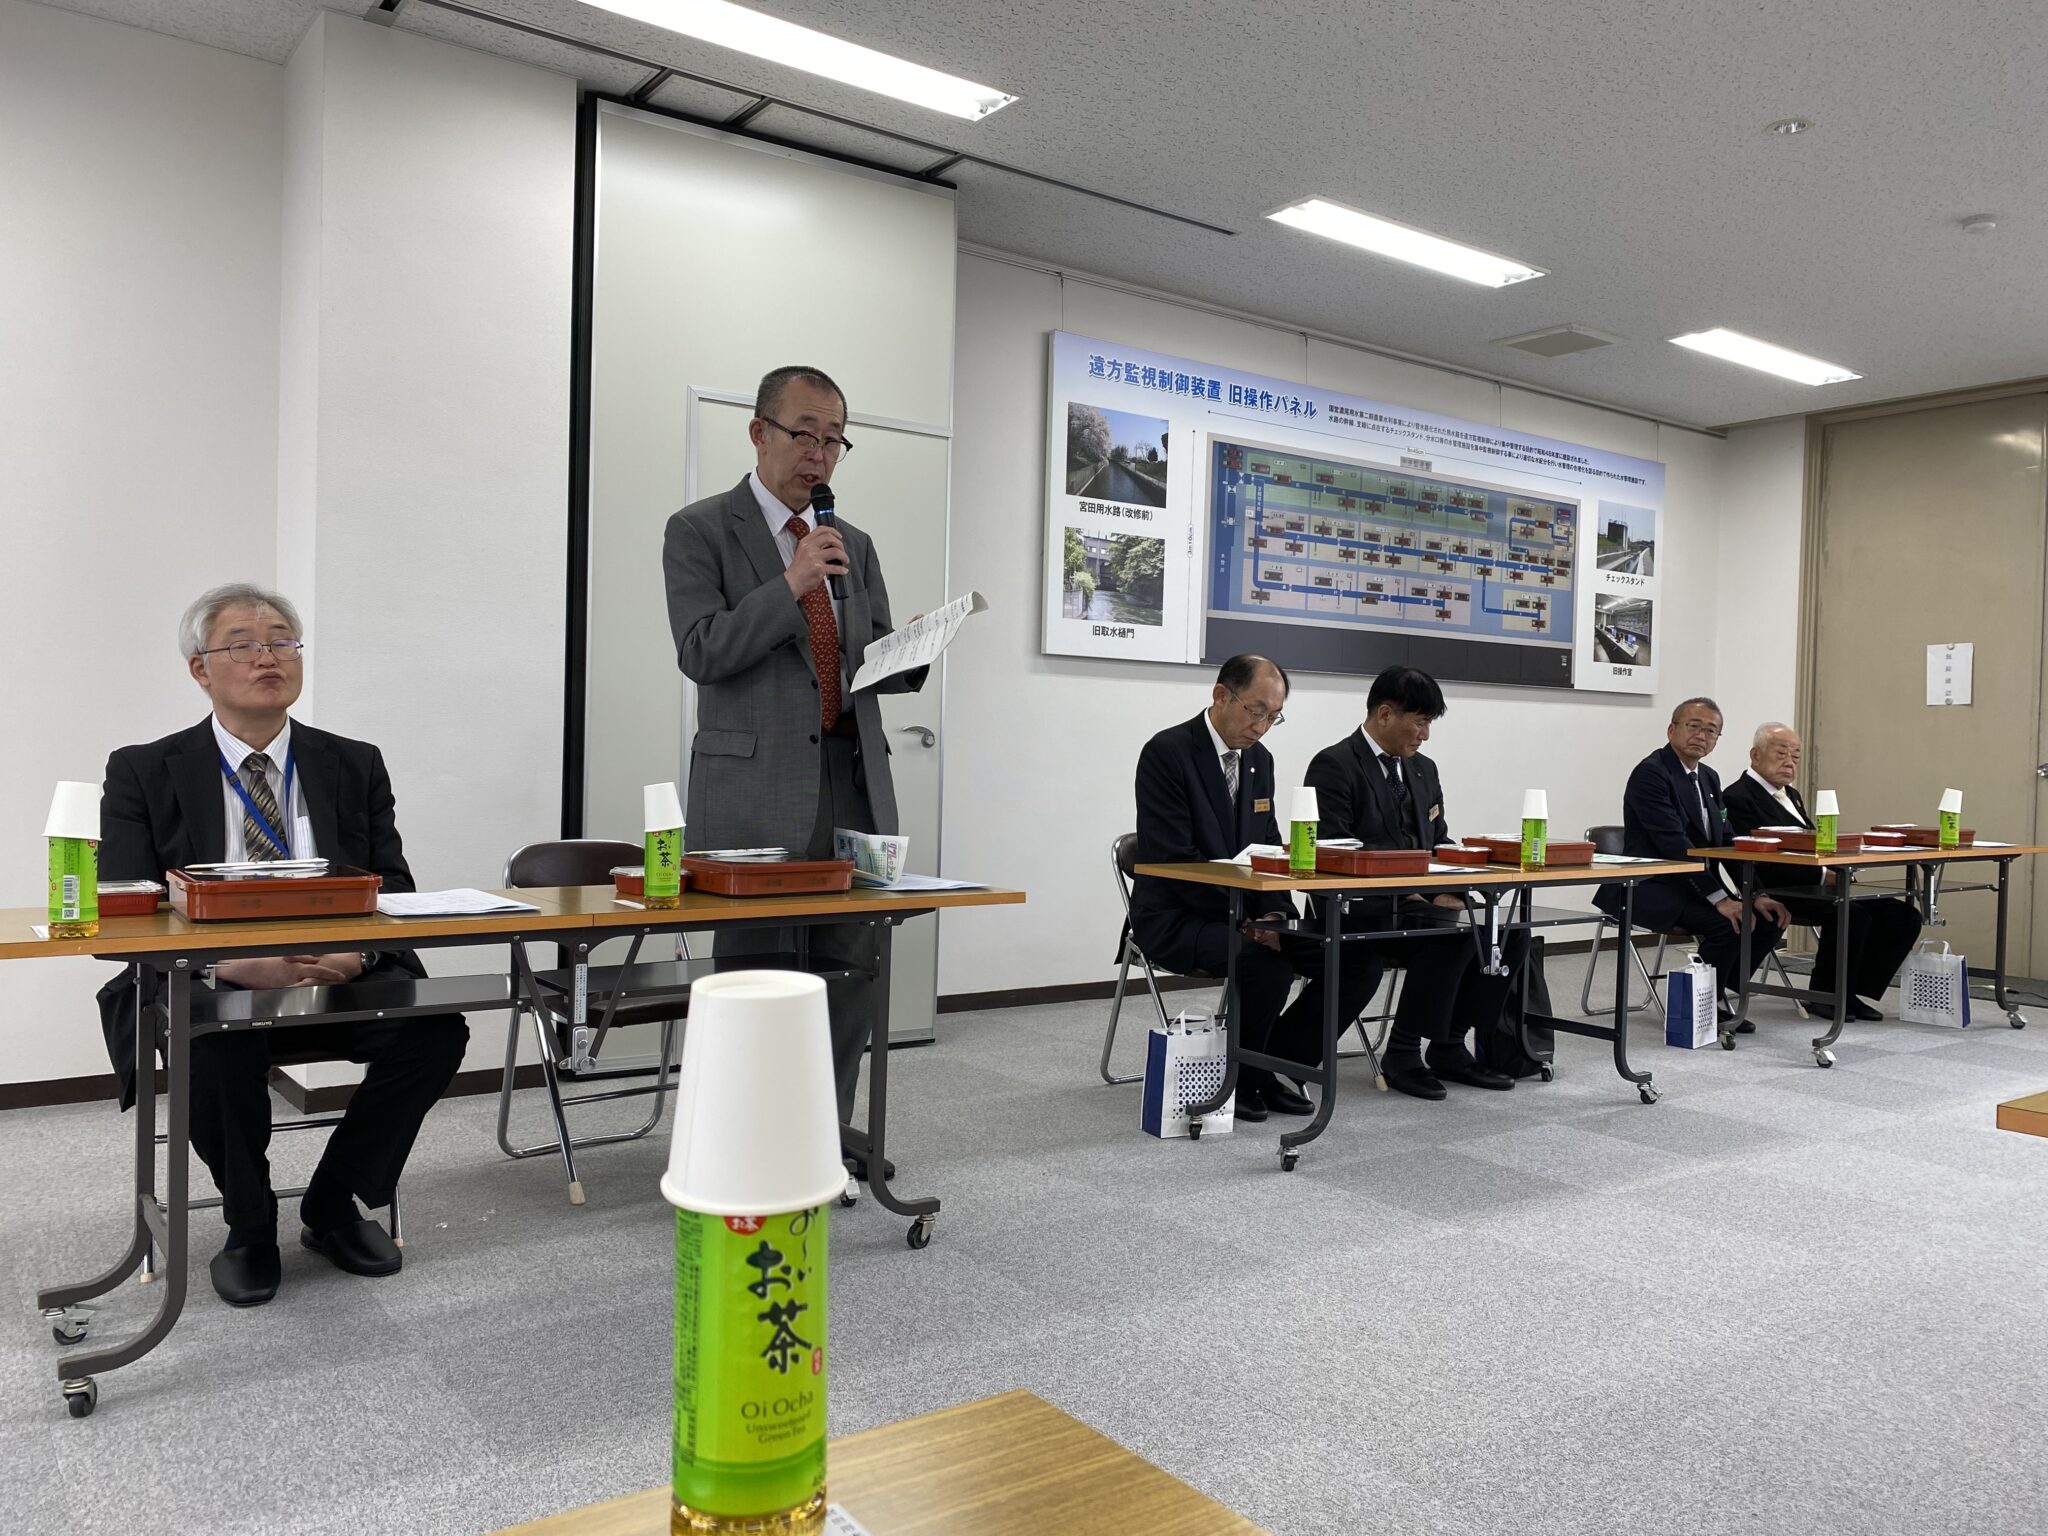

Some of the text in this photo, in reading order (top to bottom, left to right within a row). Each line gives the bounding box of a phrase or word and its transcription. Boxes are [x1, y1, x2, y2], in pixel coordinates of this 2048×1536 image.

[1088, 354, 1318, 418] 遠方監視制御装置 旧操作パネル
[1606, 573, 1645, 586] チェックスタンド
[1092, 625, 1135, 639] 旧取水樋門
[746, 1240, 812, 1374] お茶
[741, 1391, 813, 1419] Oi Ocha
[758, 1430, 791, 1444] Green
